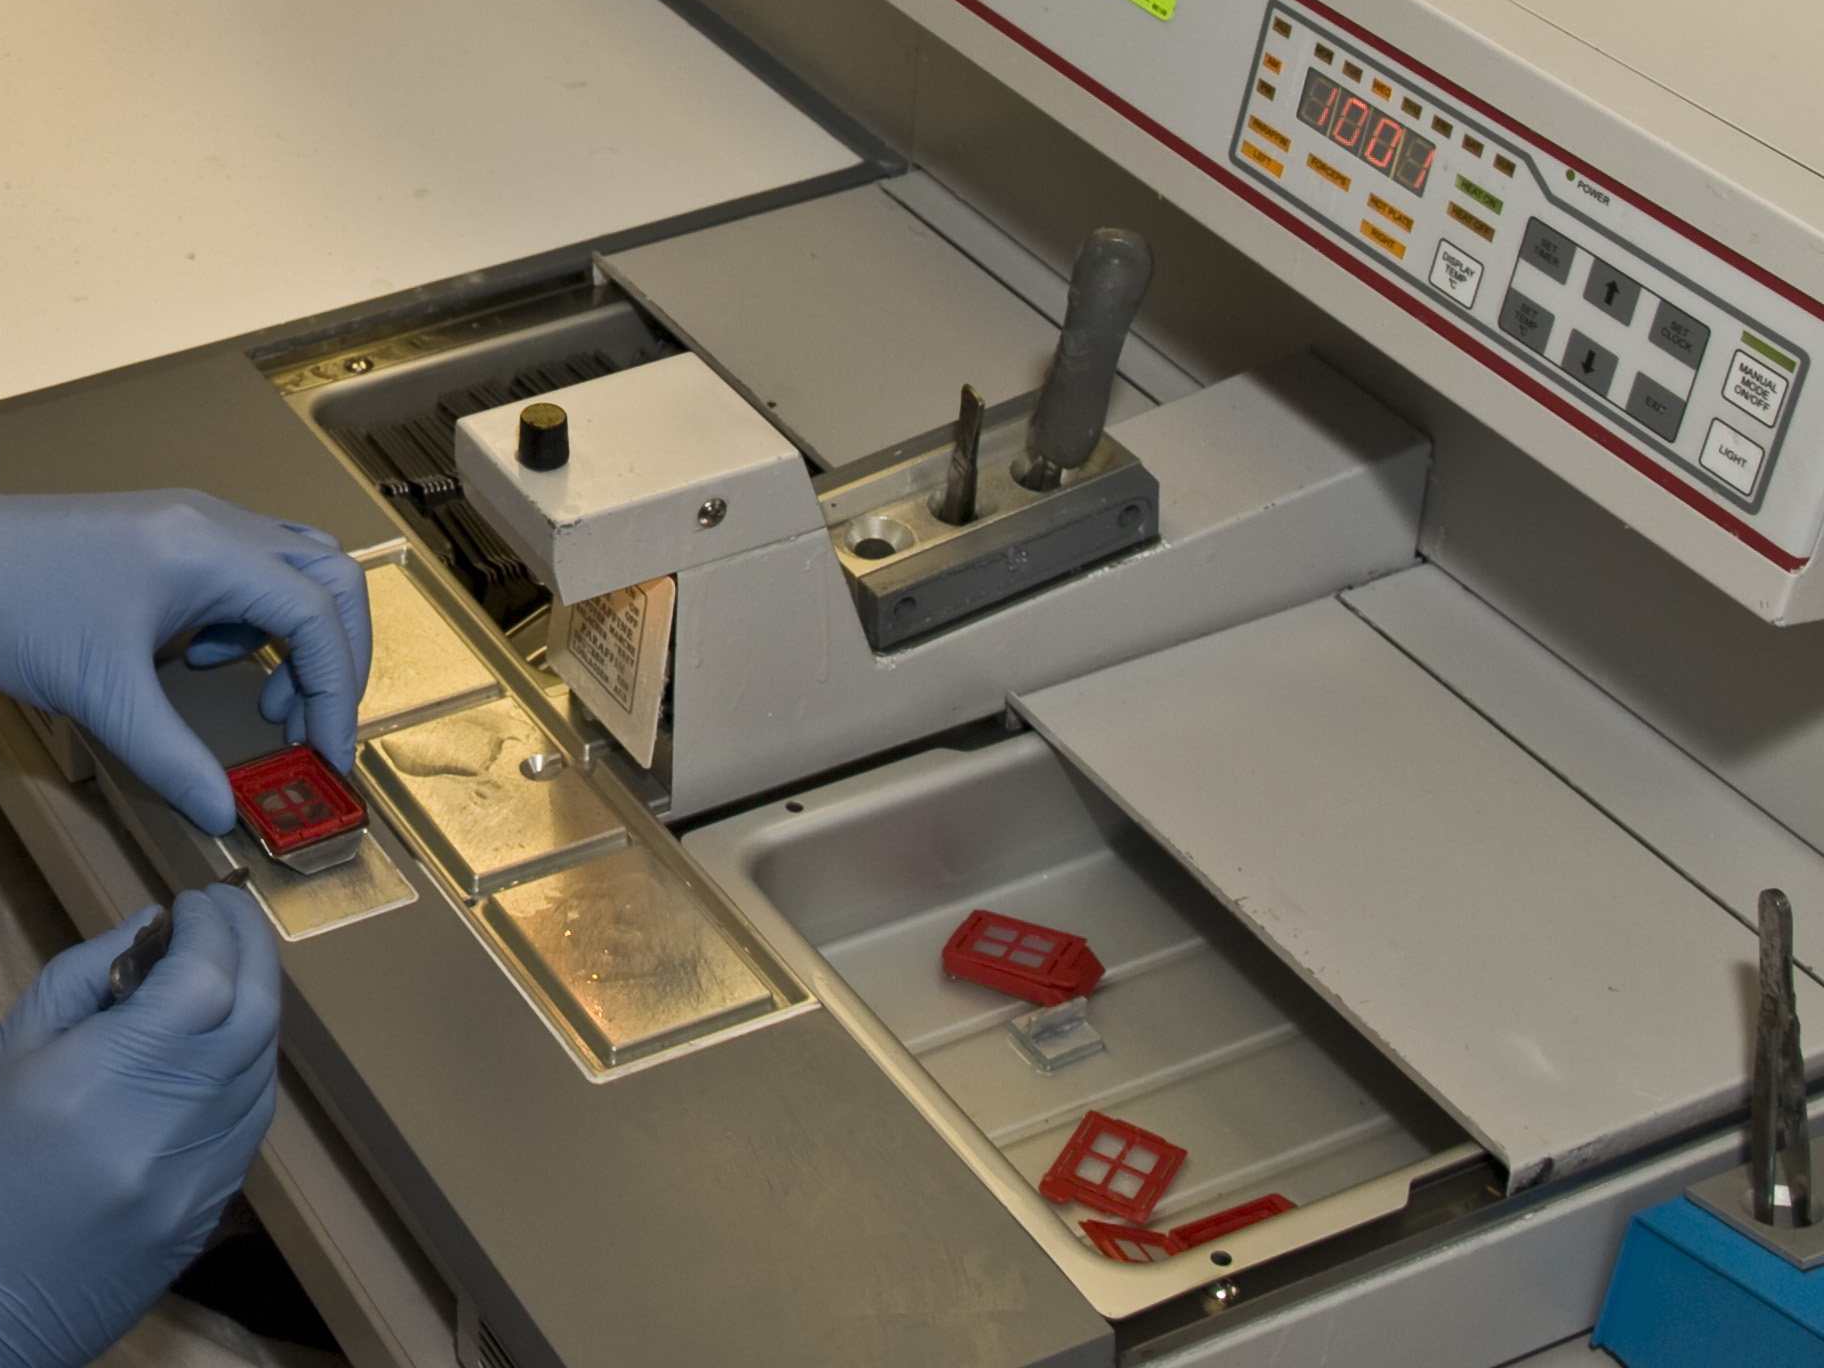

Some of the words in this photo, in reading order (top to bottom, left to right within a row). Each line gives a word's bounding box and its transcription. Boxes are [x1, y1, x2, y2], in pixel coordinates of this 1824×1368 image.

[1252, 118, 1288, 148] PARAFFIN
[1318, 87, 1436, 189] 1001
[1253, 149, 1274, 167] LEFT
[1310, 154, 1348, 187] FORCEPS
[1460, 178, 1483, 199] HEAT
[1484, 194, 1499, 209] ON
[1577, 180, 1610, 206] POWER
[1369, 195, 1388, 212] HOT
[1387, 205, 1413, 229] PLATE
[1452, 206, 1475, 227] HEAT
[1474, 218, 1490, 234] OFF
[1370, 226, 1397, 249] RIGHT
[1540, 238, 1558, 253] SET
[1442, 251, 1475, 277] DISPLAY
[1534, 244, 1560, 267] TIMER
[1445, 264, 1467, 283] TEMP
[1515, 310, 1538, 330] TEMP
[1519, 303, 1539, 317] SET
[1660, 327, 1693, 353] CLOCK
[1670, 321, 1690, 337] SET
[1739, 362, 1778, 394] MANUAL
[1741, 377, 1770, 400] MODE
[1645, 396, 1667, 415] EXIT
[1734, 385, 1771, 412] ON/OFF
[1719, 444, 1748, 469] LIGHT
[624, 611, 638, 628] OFF
